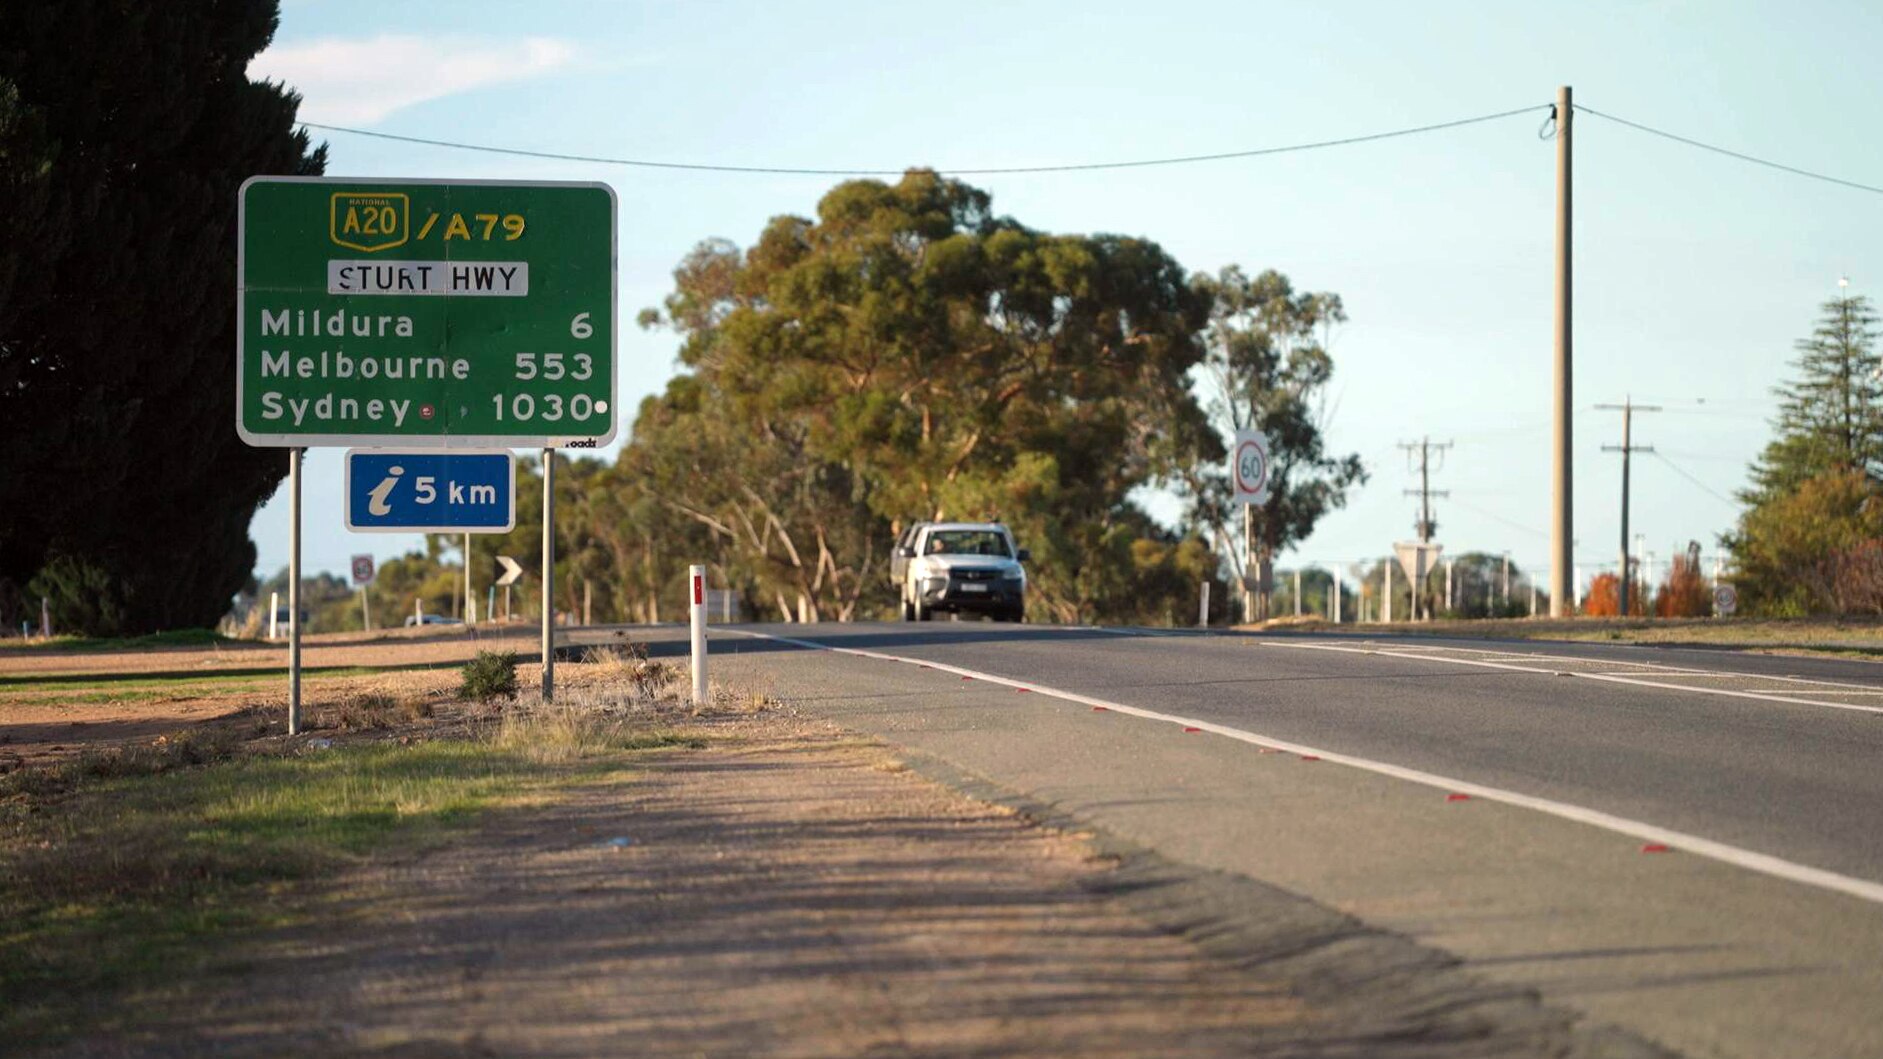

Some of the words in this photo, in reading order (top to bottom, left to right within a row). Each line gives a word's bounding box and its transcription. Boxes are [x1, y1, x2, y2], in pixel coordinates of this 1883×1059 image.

[349, 198, 391, 206] NATIONAL
[343, 207, 397, 235] A20
[338, 266, 432, 290] STURT
[452, 267, 518, 291] HWY
[261, 309, 414, 337] Mildura
[570, 312, 594, 339] 6
[261, 350, 470, 380] Melbourne
[515, 352, 593, 381] 553
[261, 391, 411, 427] Sydney
[492, 393, 593, 421] 1030
[565, 437, 597, 448] oads
[1241, 456, 1261, 479] 60
[414, 476, 437, 504] 5
[448, 479, 496, 504] km
